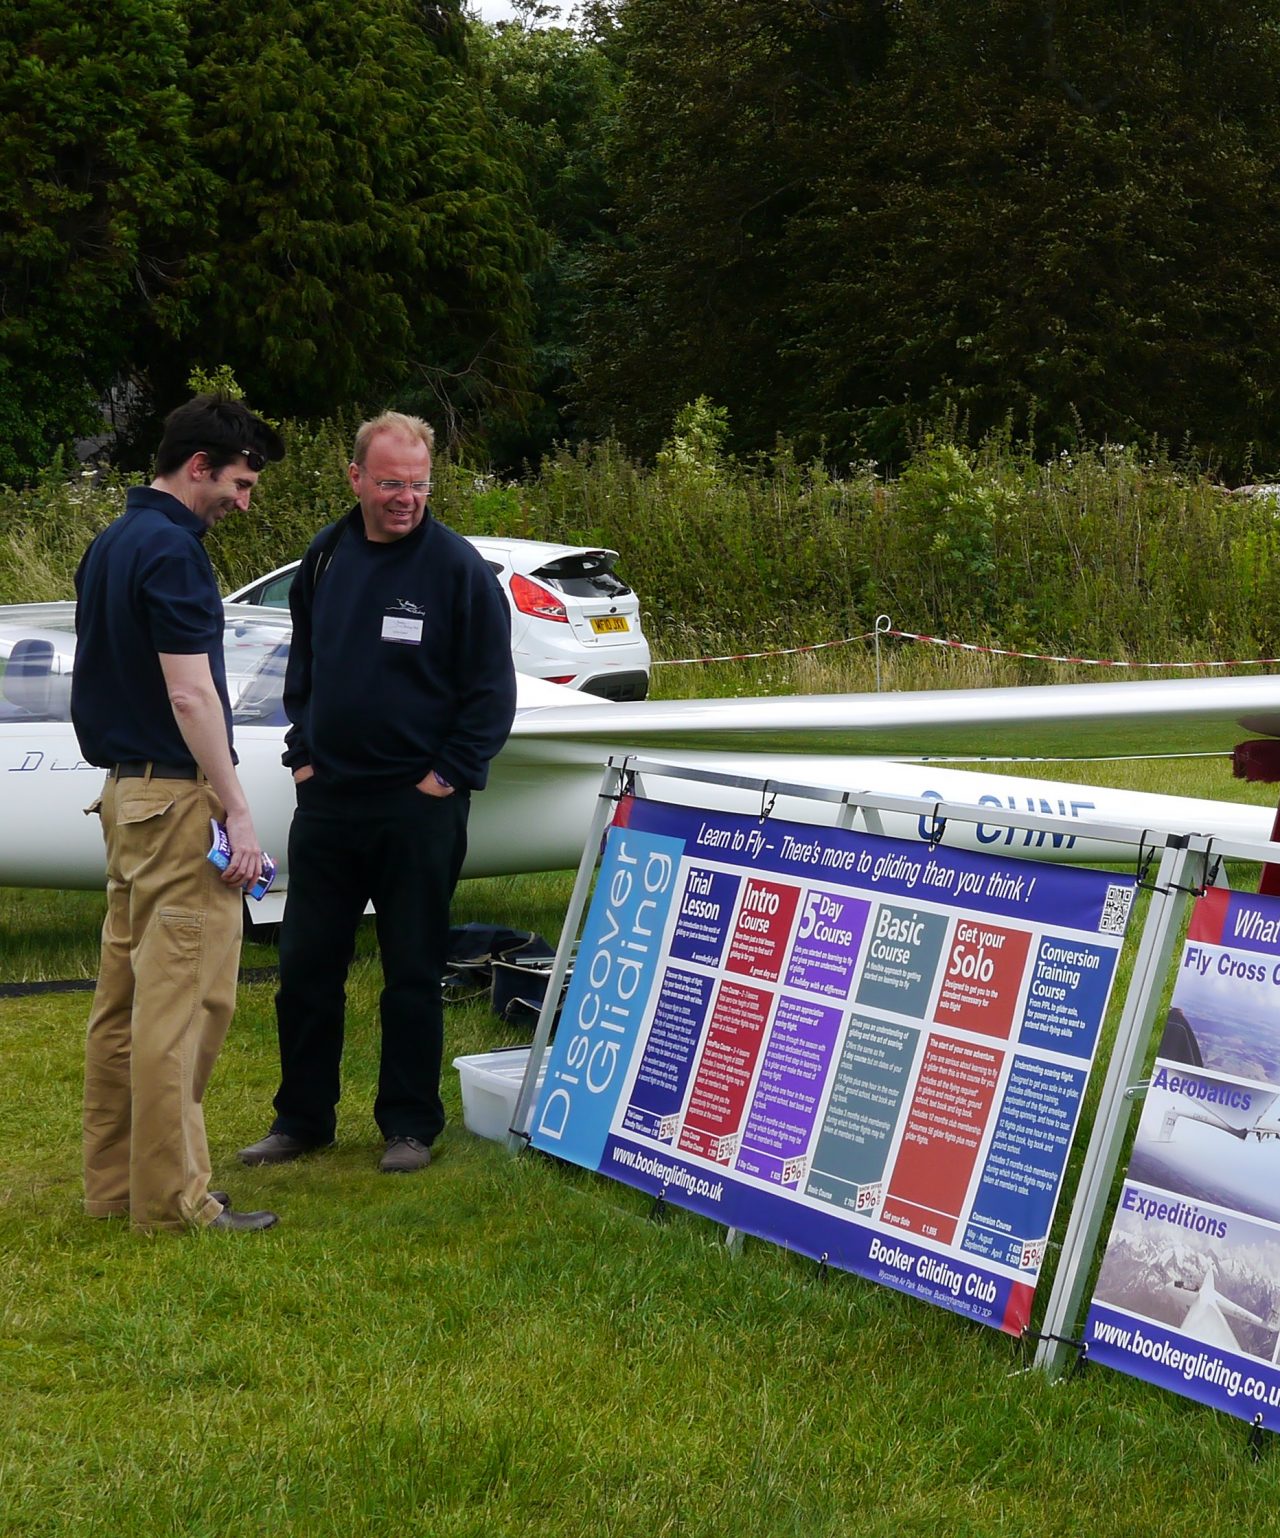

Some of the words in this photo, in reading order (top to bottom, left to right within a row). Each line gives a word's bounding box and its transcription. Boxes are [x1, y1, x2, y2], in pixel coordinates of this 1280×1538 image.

[695, 822, 732, 849] Learn
[730, 828, 745, 851] to
[744, 829, 766, 859] Fly
[779, 835, 821, 864] There's
[819, 847, 856, 870] more
[856, 849, 873, 873] to
[870, 852, 922, 888] gliding
[921, 860, 955, 889] than
[952, 871, 986, 897] you
[985, 871, 1025, 901] think
[687, 870, 714, 896] Trial
[742, 882, 780, 915] Intro
[681, 892, 720, 921] Lesson
[738, 910, 770, 934] Course
[797, 891, 823, 939] 5
[818, 895, 844, 923] Day
[813, 920, 853, 947] Course
[875, 908, 925, 946] Basic
[956, 922, 979, 944] Get
[976, 930, 1006, 951] your
[870, 938, 911, 965] Course
[948, 944, 994, 982] Solo
[1040, 941, 1100, 969] Conversion
[1183, 946, 1213, 976] Fly
[1216, 953, 1267, 983] Cross
[586, 851, 672, 1094] Gliding
[1031, 979, 1075, 1001] Course
[1036, 959, 1081, 990] Training
[538, 841, 638, 1141] Discover
[1153, 1068, 1252, 1111] Aerobatics
[612, 1146, 724, 1202] www.bookergliding.co.uk
[1121, 1187, 1227, 1239] Expeditions
[868, 1237, 916, 1273] Booker
[915, 1255, 963, 1296] Gliding
[964, 1272, 997, 1304] Club
